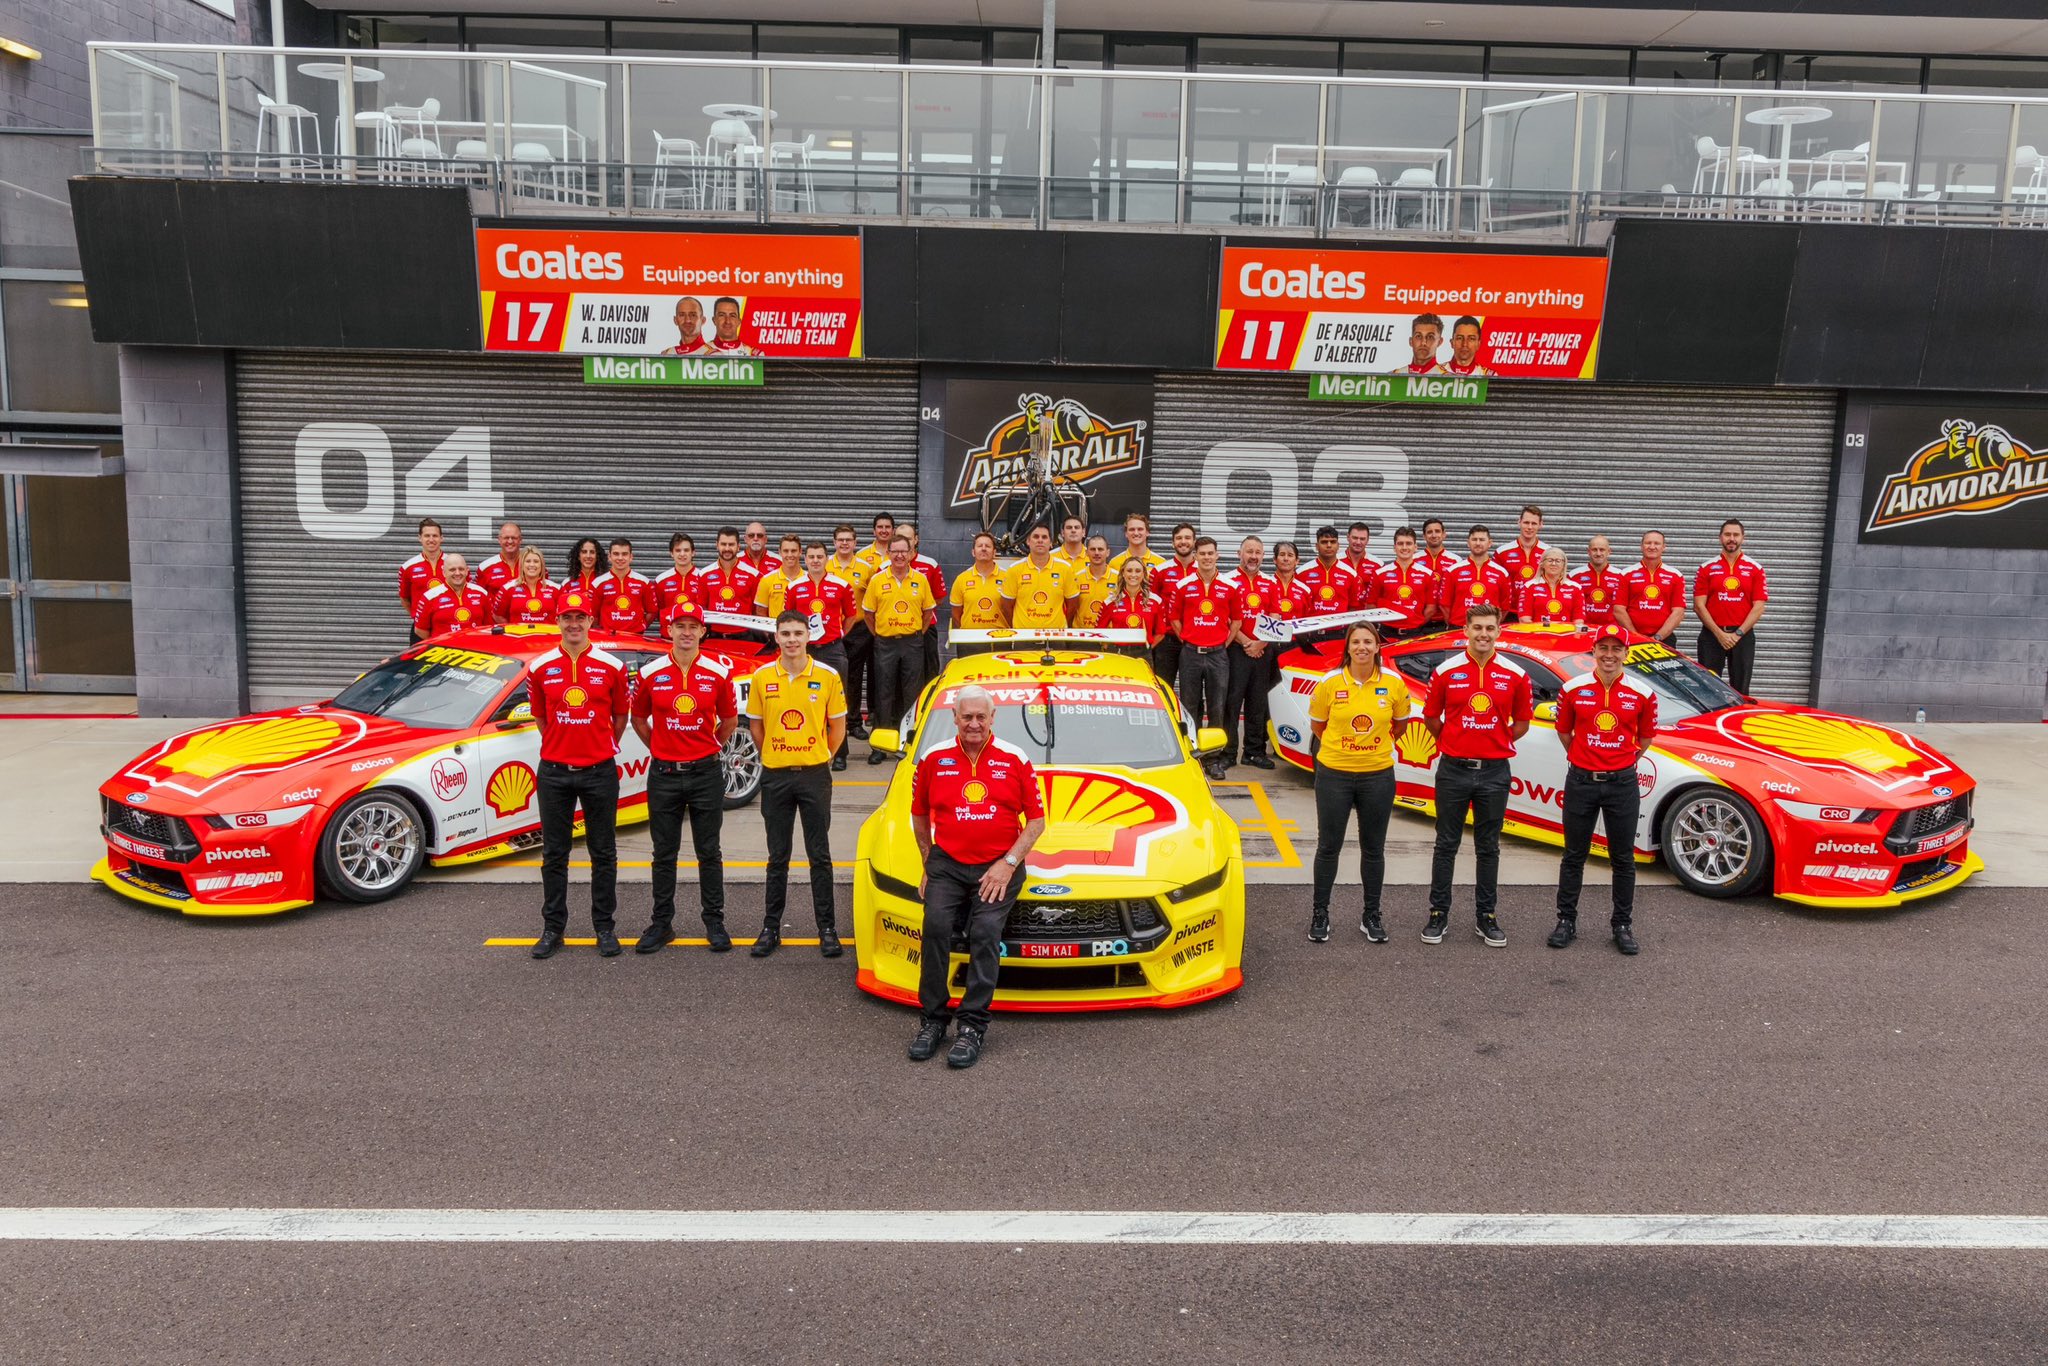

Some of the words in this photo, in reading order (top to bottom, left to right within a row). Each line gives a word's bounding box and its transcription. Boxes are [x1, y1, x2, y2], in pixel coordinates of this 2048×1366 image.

[496, 243, 624, 281] Coates
[643, 264, 731, 286] Equipped
[734, 267, 759, 285] for
[765, 268, 843, 288] anything
[1239, 262, 1366, 299] Coates
[1384, 284, 1472, 305] Equipped
[1475, 286, 1501, 304] for
[1505, 288, 1584, 309] anything
[505, 301, 554, 342] 17
[581, 304, 597, 321] W.
[600, 305, 650, 323] DAVISON
[752, 310, 788, 328] SHELL
[791, 311, 846, 329] V-POWER
[581, 326, 597, 344] A.
[600, 327, 647, 345] DAVISON
[759, 328, 802, 345] RACING
[804, 329, 837, 346] TEAM
[1240, 320, 1285, 360] 11
[1316, 323, 1332, 340] DE
[1334, 324, 1395, 342] PASQUALE
[1487, 332, 1523, 349] SHELL
[1526, 333, 1582, 350] V-POWER
[1314, 345, 1377, 364] D'ALBERTO
[1491, 348, 1535, 365] RACING
[1537, 349, 1571, 366] TEAM
[593, 358, 666, 380] Merlin
[682, 358, 754, 381] Merlin
[1318, 375, 1391, 397] Merlin
[1406, 376, 1478, 400] Merlin
[921, 407, 941, 421] 04
[1846, 433, 1865, 447] 03
[295, 422, 505, 540] 04
[1200, 441, 1410, 560] 03
[414, 646, 514, 674] PIRTEK
[963, 671, 1020, 684] Shell
[1027, 670, 1134, 683] V-Power
[1046, 685, 1154, 705] Norman
[1028, 705, 1047, 715] 98
[557, 716, 592, 724] V-Power
[666, 723, 700, 731] V-Power
[1462, 721, 1496, 729] V-Power
[772, 744, 812, 752] V-Power
[1342, 741, 1378, 751] V-Power
[1587, 739, 1622, 748] V-Power
[351, 757, 394, 772] 4Ddoors
[1692, 752, 1736, 769] 4Ddoors
[432, 759, 465, 794] Rheem
[282, 786, 322, 803] nectr
[1760, 780, 1800, 794] nectr
[237, 815, 267, 826] CRC
[447, 807, 481, 821] DUNLOP
[956, 812, 994, 821] V-Power
[1821, 808, 1849, 820] CRC
[133, 843, 159, 858] THREES
[1922, 837, 1944, 851] THREE
[232, 871, 283, 890] Repco
[1834, 864, 1890, 882] Repco
[1035, 884, 1066, 895] Ford
[906, 947, 921, 965] WM
[1031, 945, 1050, 956] SIM
[1053, 945, 1072, 956] KAI
[1092, 941, 1128, 957] PPQ
[1171, 950, 1186, 968] WM
[1184, 939, 1214, 961] WASTE
